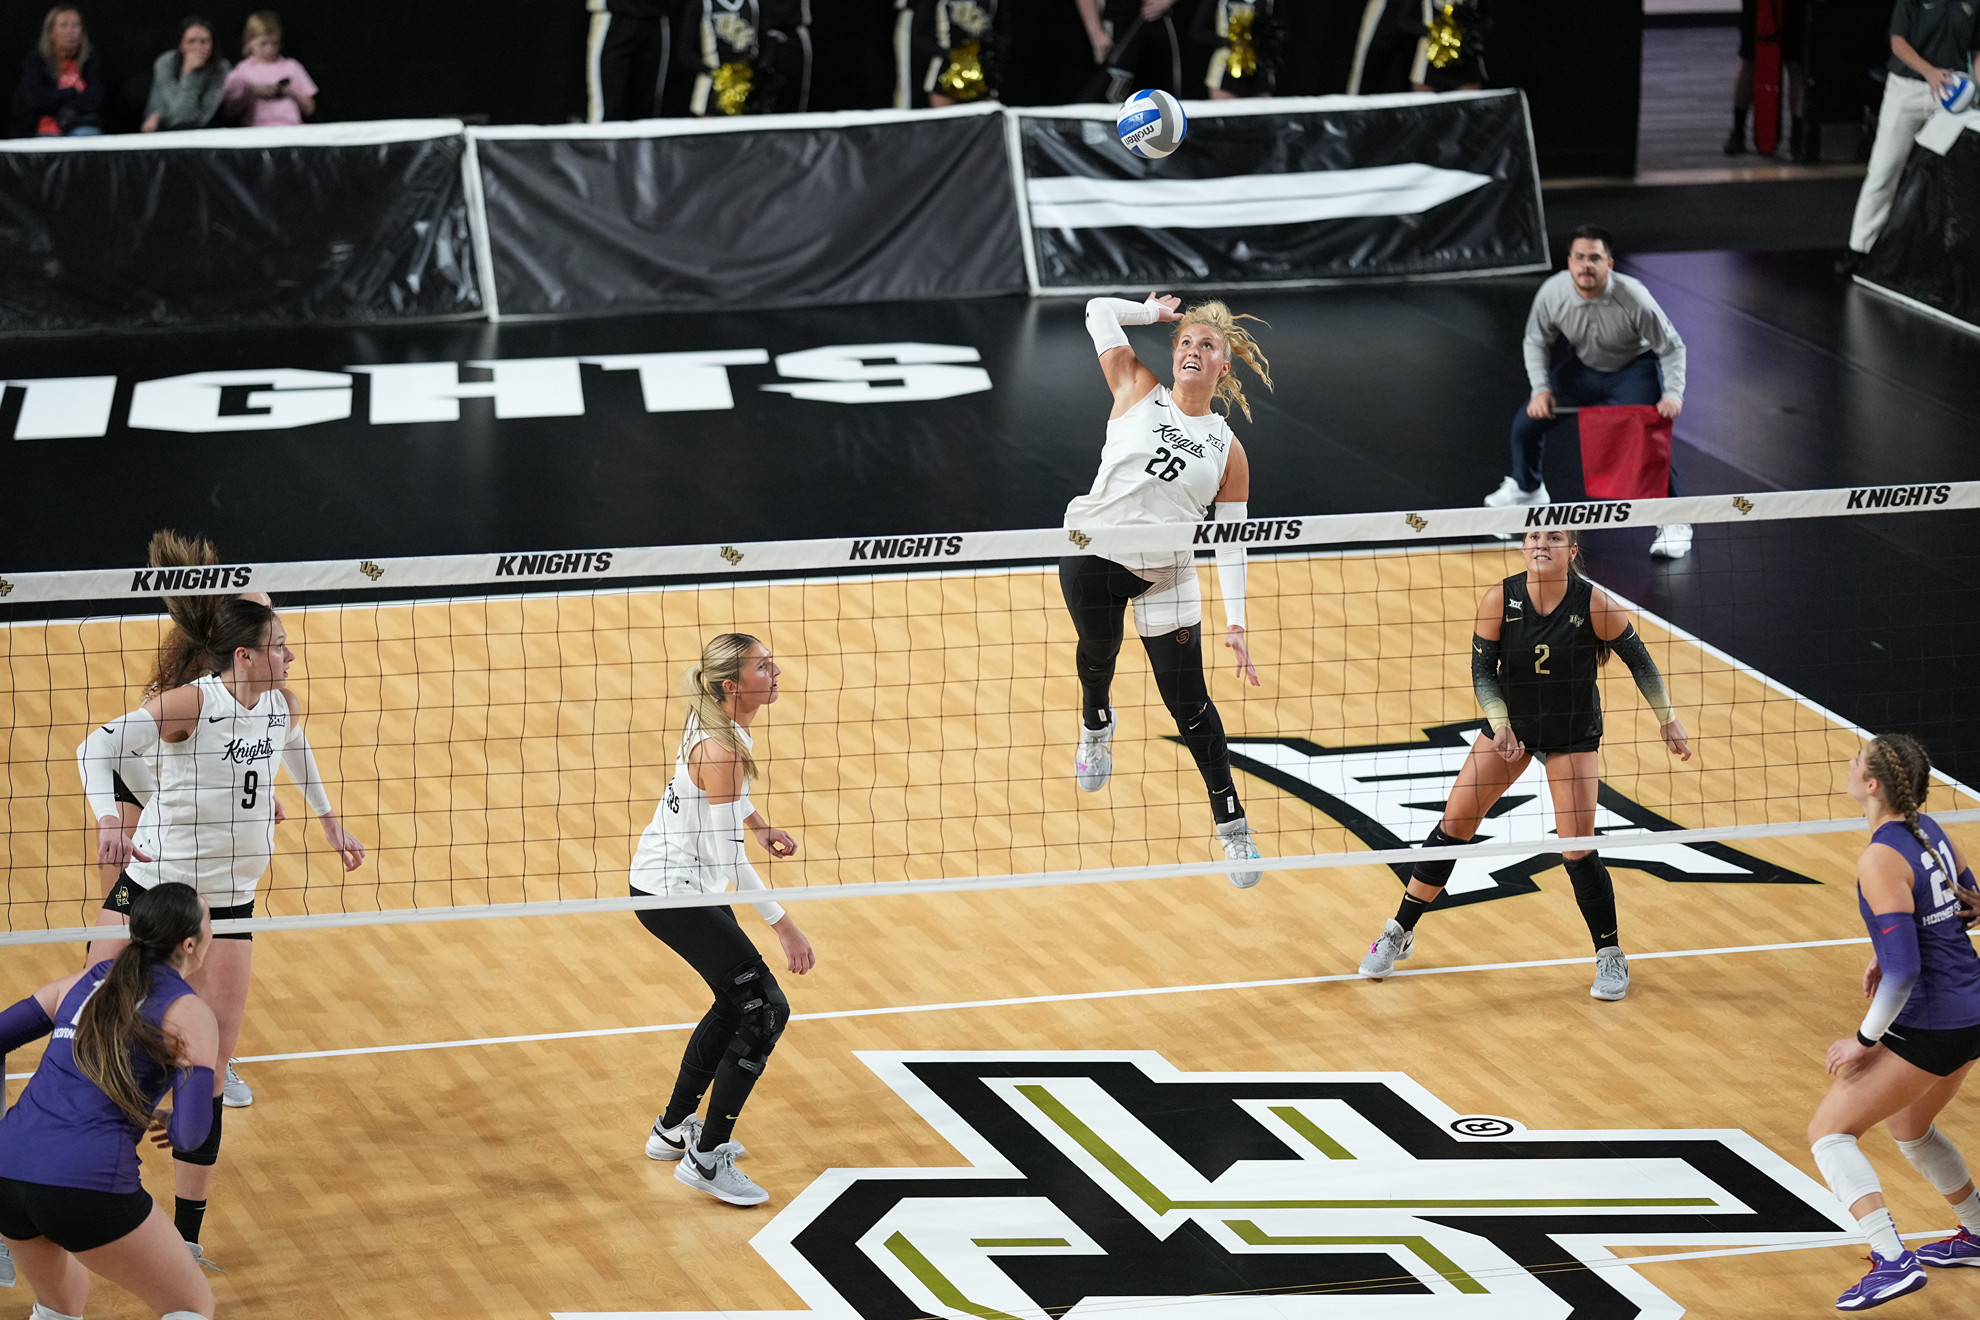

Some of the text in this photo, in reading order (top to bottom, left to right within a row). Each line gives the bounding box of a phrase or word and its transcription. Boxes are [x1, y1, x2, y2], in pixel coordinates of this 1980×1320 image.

[1124, 124, 1155, 145] molten
[0, 343, 993, 440] IGHTS
[1152, 423, 1206, 459] Knights
[1144, 446, 1187, 482] 26
[1732, 496, 1755, 516] UCF
[1846, 485, 1952, 510] KNIGHTS
[1406, 513, 1429, 532] UCF
[1524, 503, 1632, 527] KNIGHTS
[1069, 530, 1092, 550] UCF
[1192, 520, 1303, 545] KNIGHTS
[720, 546, 744, 566] UCF
[849, 536, 963, 561] KNIGHTS
[360, 561, 384, 582] UCF
[495, 552, 613, 577] KNIGHTS
[0, 576, 14, 597] CF
[131, 566, 252, 592] KNIGHTS
[1535, 644, 1550, 675] 2
[222, 738, 274, 765] Knights
[241, 771, 258, 809] 9
[1921, 839, 1958, 908] 21
